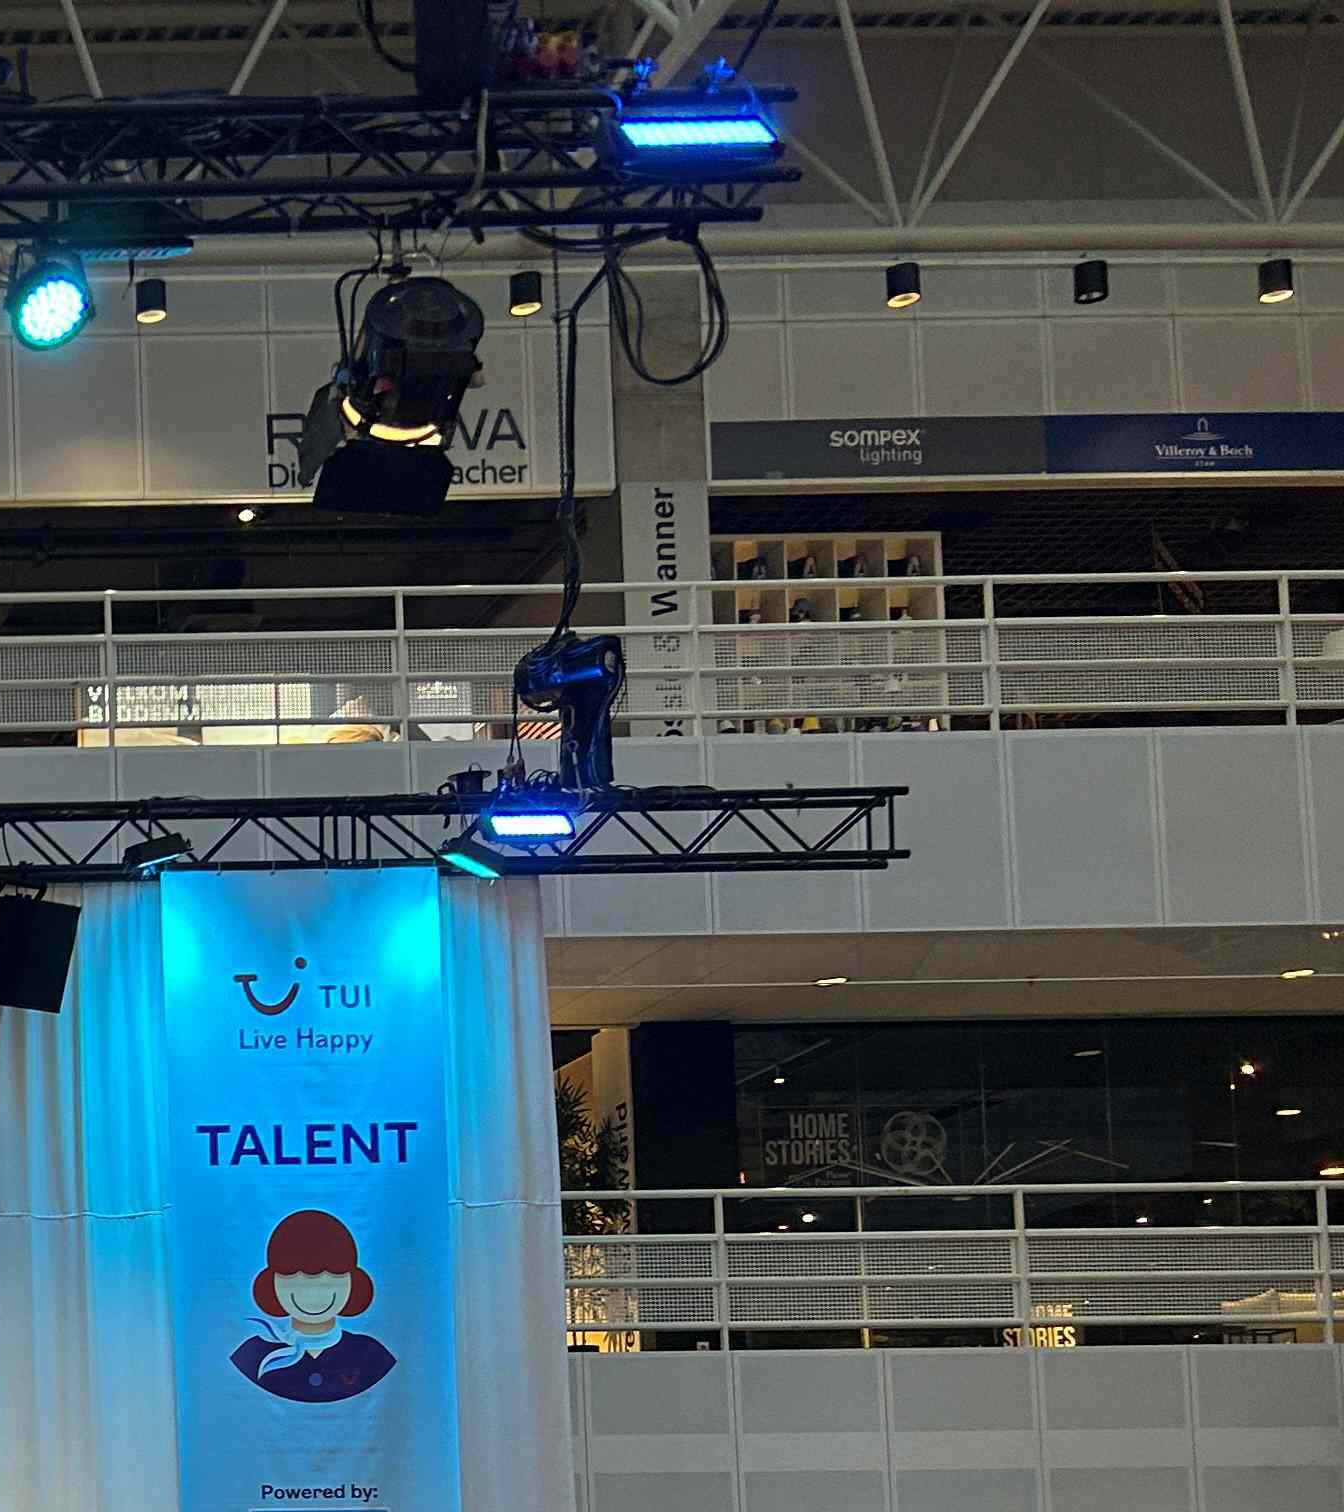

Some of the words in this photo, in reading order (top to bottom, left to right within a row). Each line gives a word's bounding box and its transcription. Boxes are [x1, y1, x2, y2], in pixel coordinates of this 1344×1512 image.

[860, 447, 923, 465] lighting
[1154, 444, 1205, 457] Villeroy
[1220, 444, 1253, 456] Boch
[651, 487, 678, 616] Wanner
[319, 985, 371, 1008] TUI
[239, 1029, 288, 1050] Live
[296, 1027, 374, 1053] Happy
[789, 1113, 849, 1139] HOME
[196, 1122, 418, 1166] TALENT
[765, 1140, 850, 1165] STORIES
[1003, 1327, 1076, 1347] STORIES
[261, 1484, 346, 1499] Powered
[351, 1484, 379, 1502] by:
